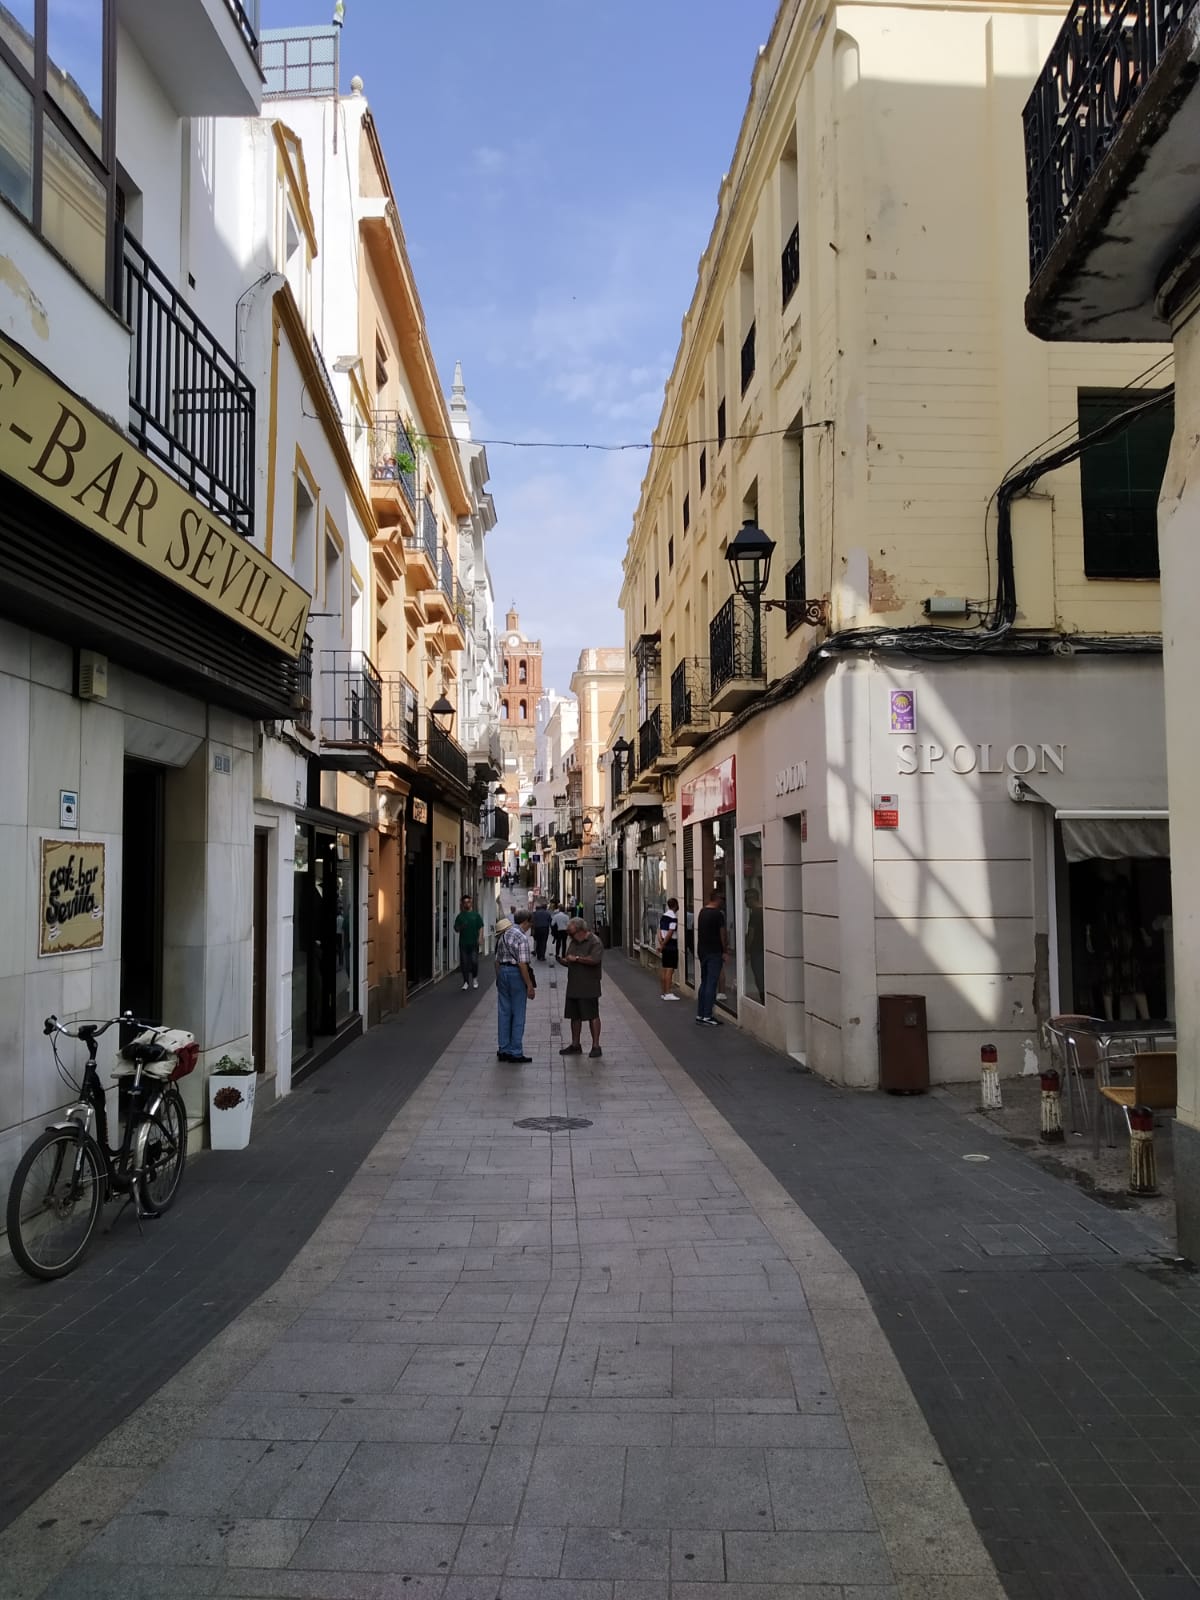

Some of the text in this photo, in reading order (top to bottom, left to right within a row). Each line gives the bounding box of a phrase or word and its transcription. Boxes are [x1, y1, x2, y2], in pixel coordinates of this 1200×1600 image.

[164, 508, 307, 651] SEVILLA
[896, 743, 1067, 775] SPOLON
[45, 884, 95, 924] Sevilla
